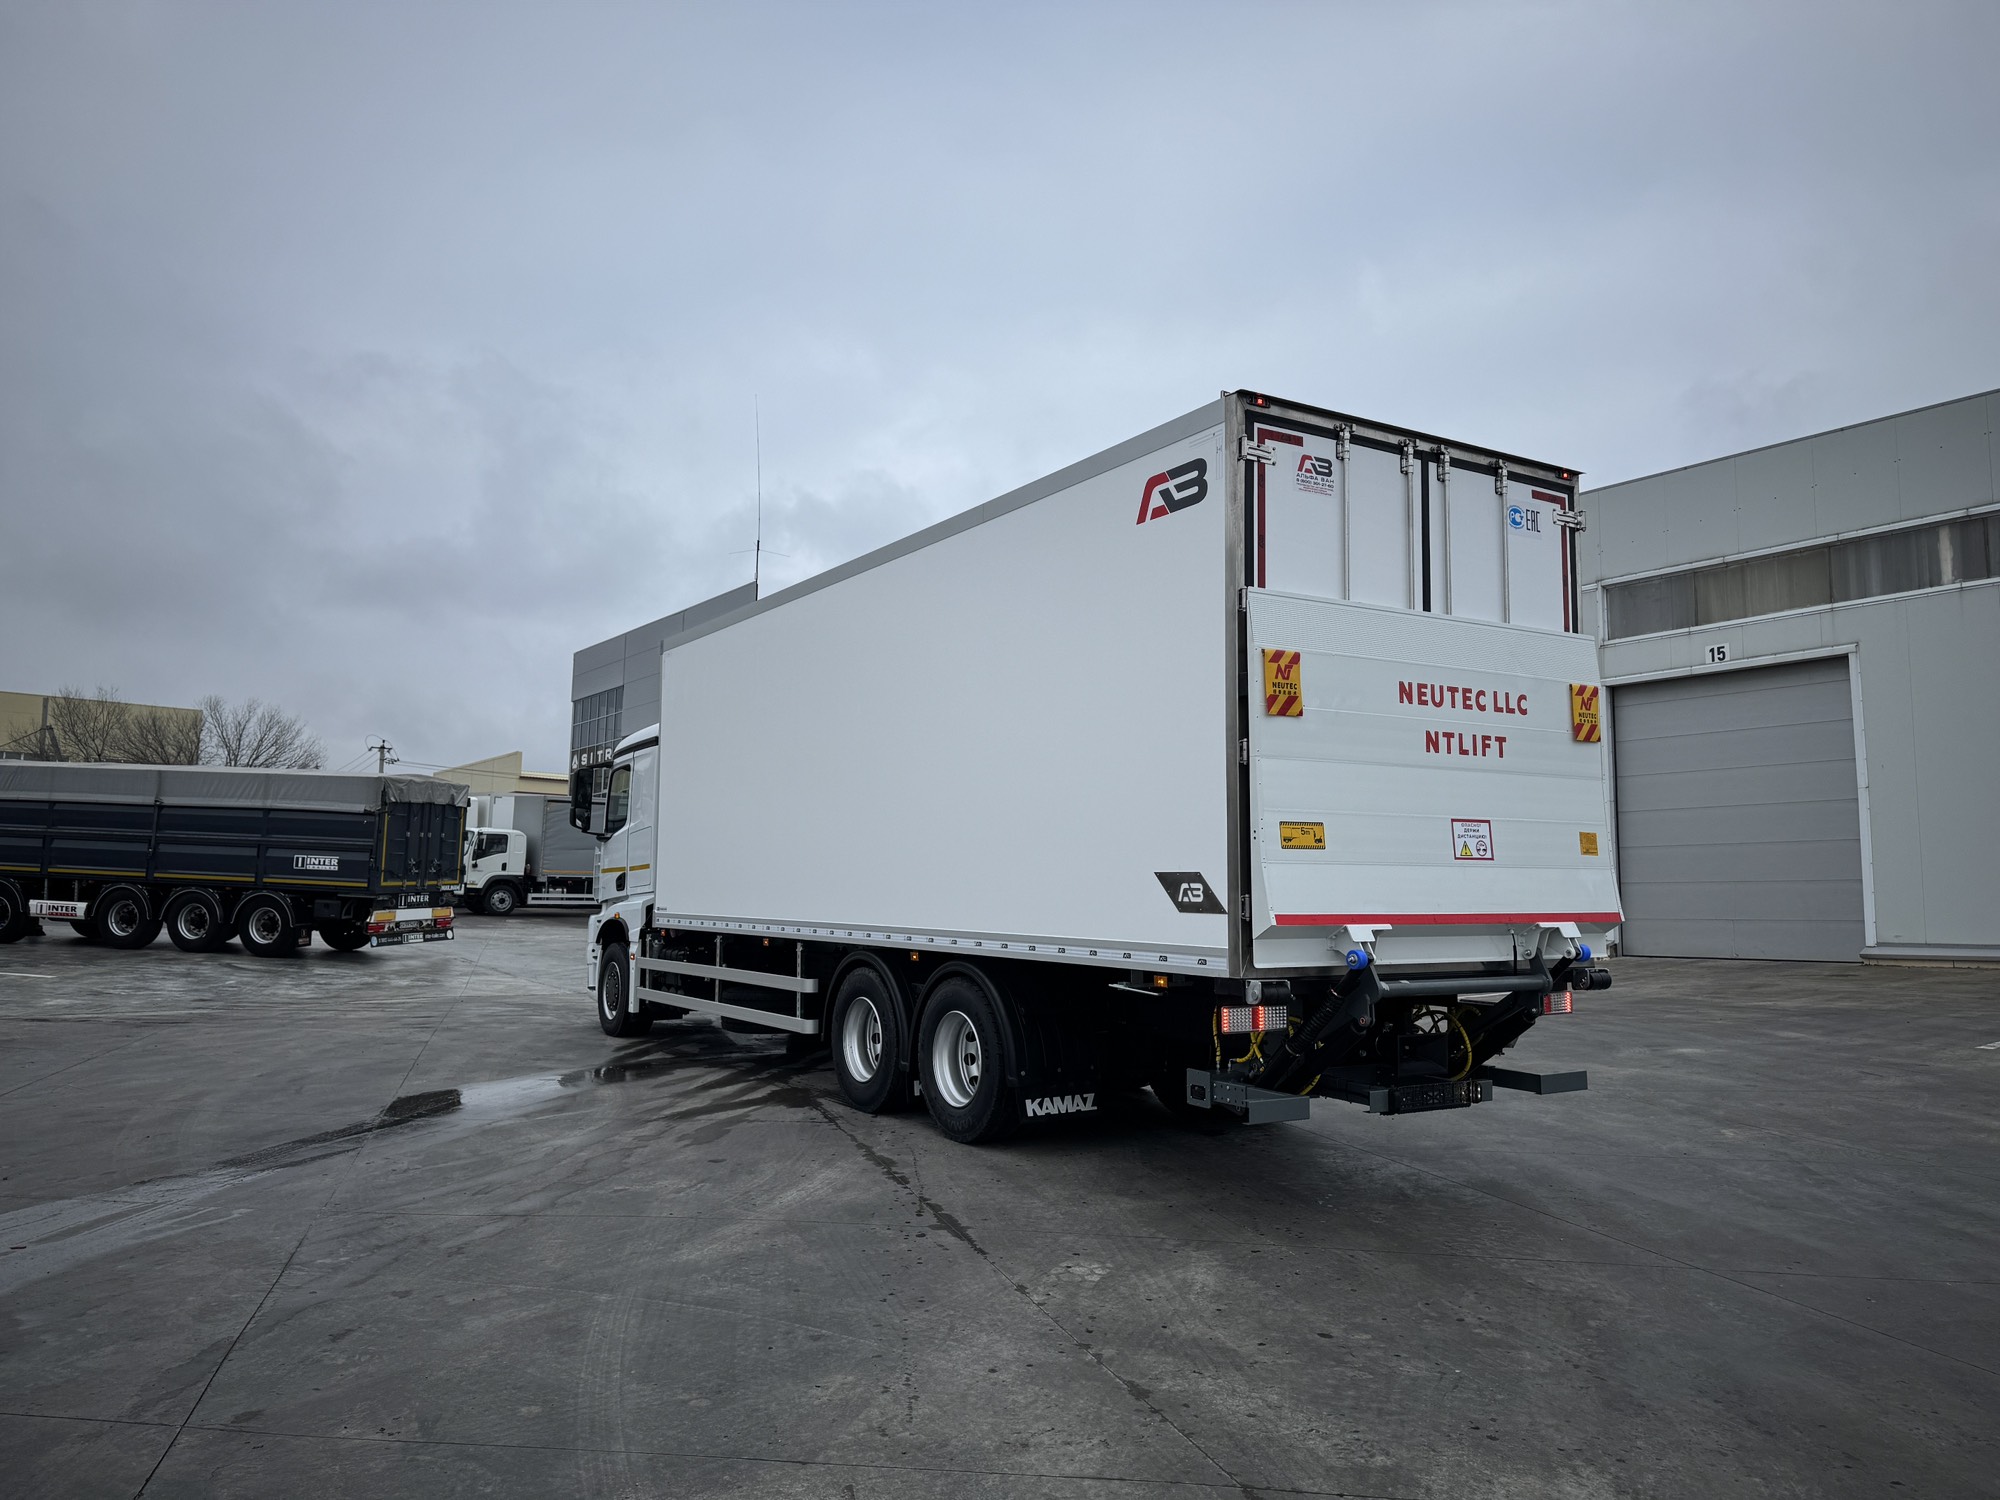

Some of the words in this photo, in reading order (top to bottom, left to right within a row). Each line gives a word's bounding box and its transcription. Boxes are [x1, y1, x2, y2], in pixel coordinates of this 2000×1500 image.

[1709, 646, 1726, 662] 15
[1272, 682, 1298, 690] NEUTEC
[1399, 681, 1487, 712] NEUTEC
[1493, 691, 1528, 716] LLC
[1578, 712, 1597, 720] NEUTEC
[1425, 730, 1507, 758] NTLIFT
[307, 858, 338, 866] INTER
[408, 895, 430, 903] INTER
[1025, 1093, 1098, 1117] KAMAZ
